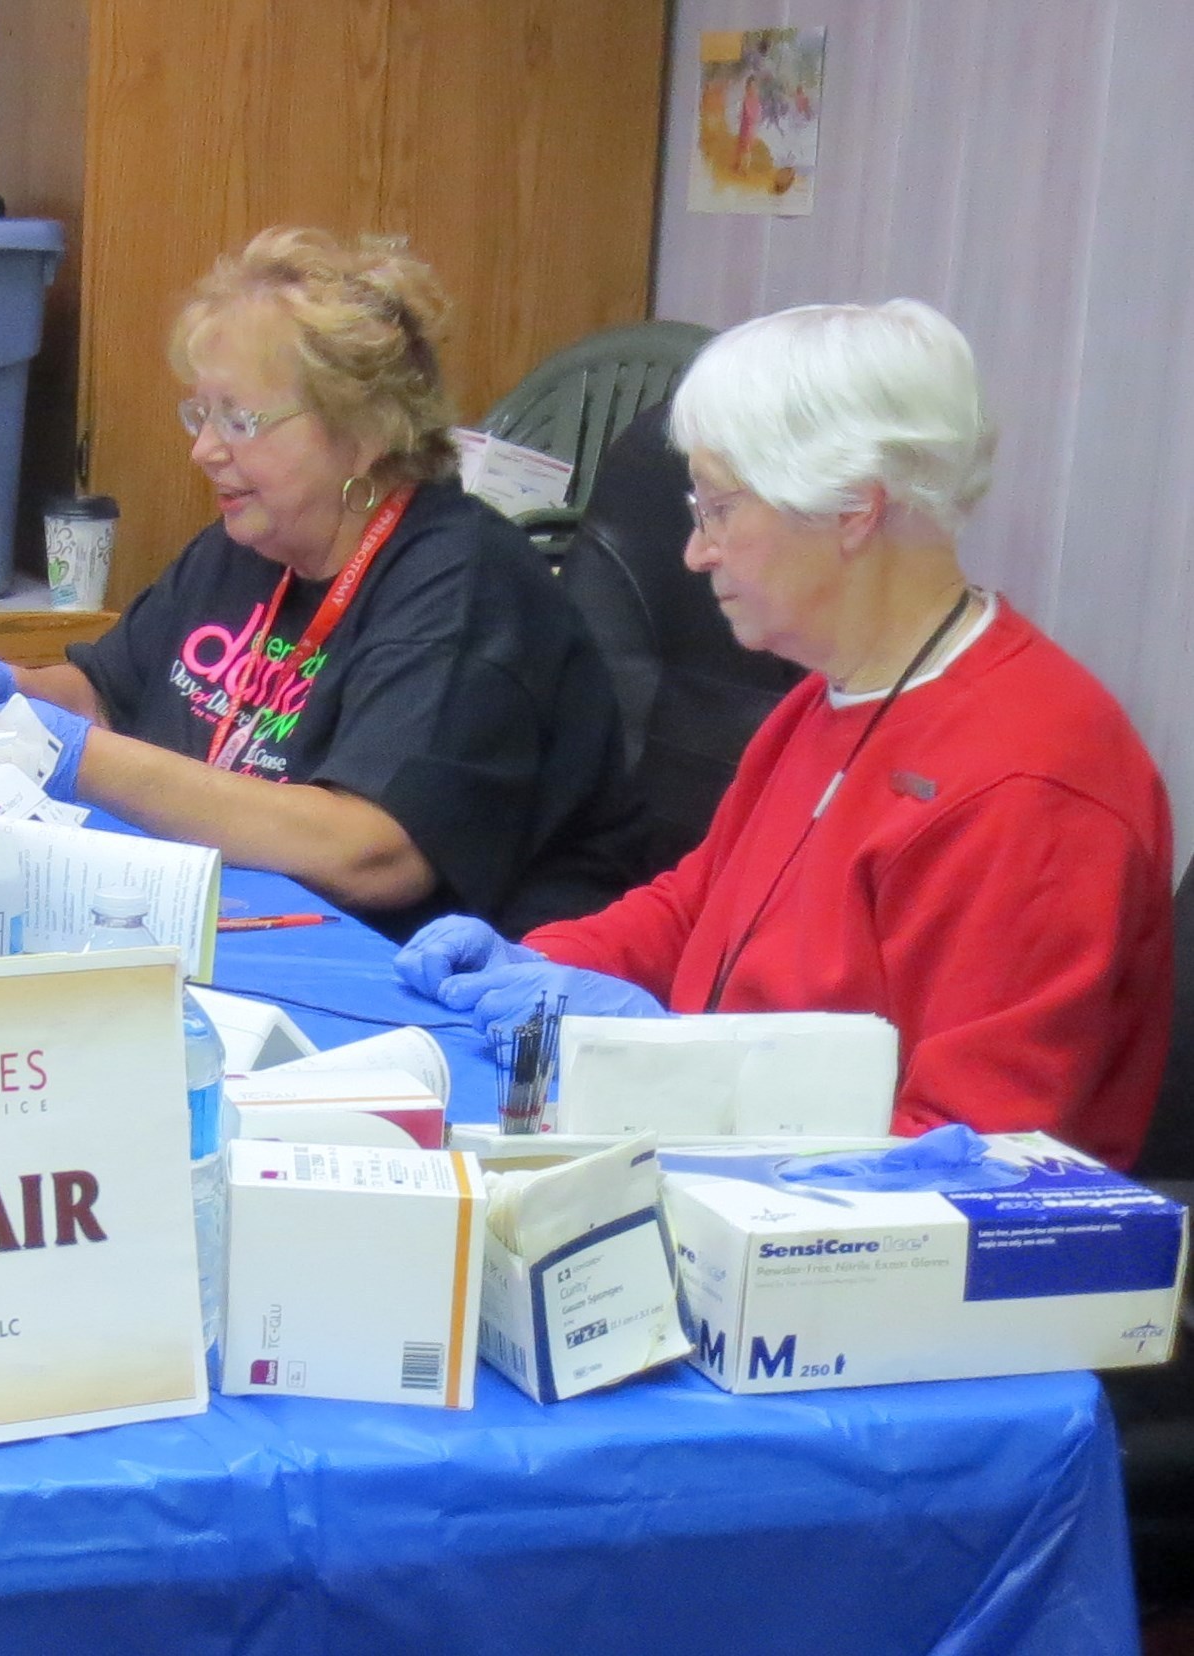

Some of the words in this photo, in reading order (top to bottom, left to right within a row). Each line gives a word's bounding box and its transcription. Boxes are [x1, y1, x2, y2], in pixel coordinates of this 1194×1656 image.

[331, 508, 396, 607] PHLEBOTOMY
[170, 659, 202, 697] Day
[206, 689, 252, 728] Dace
[759, 1237, 881, 1259] SensiCare
[699, 1318, 727, 1376] M
[748, 1333, 797, 1381] M
[800, 1363, 830, 1378] 250
